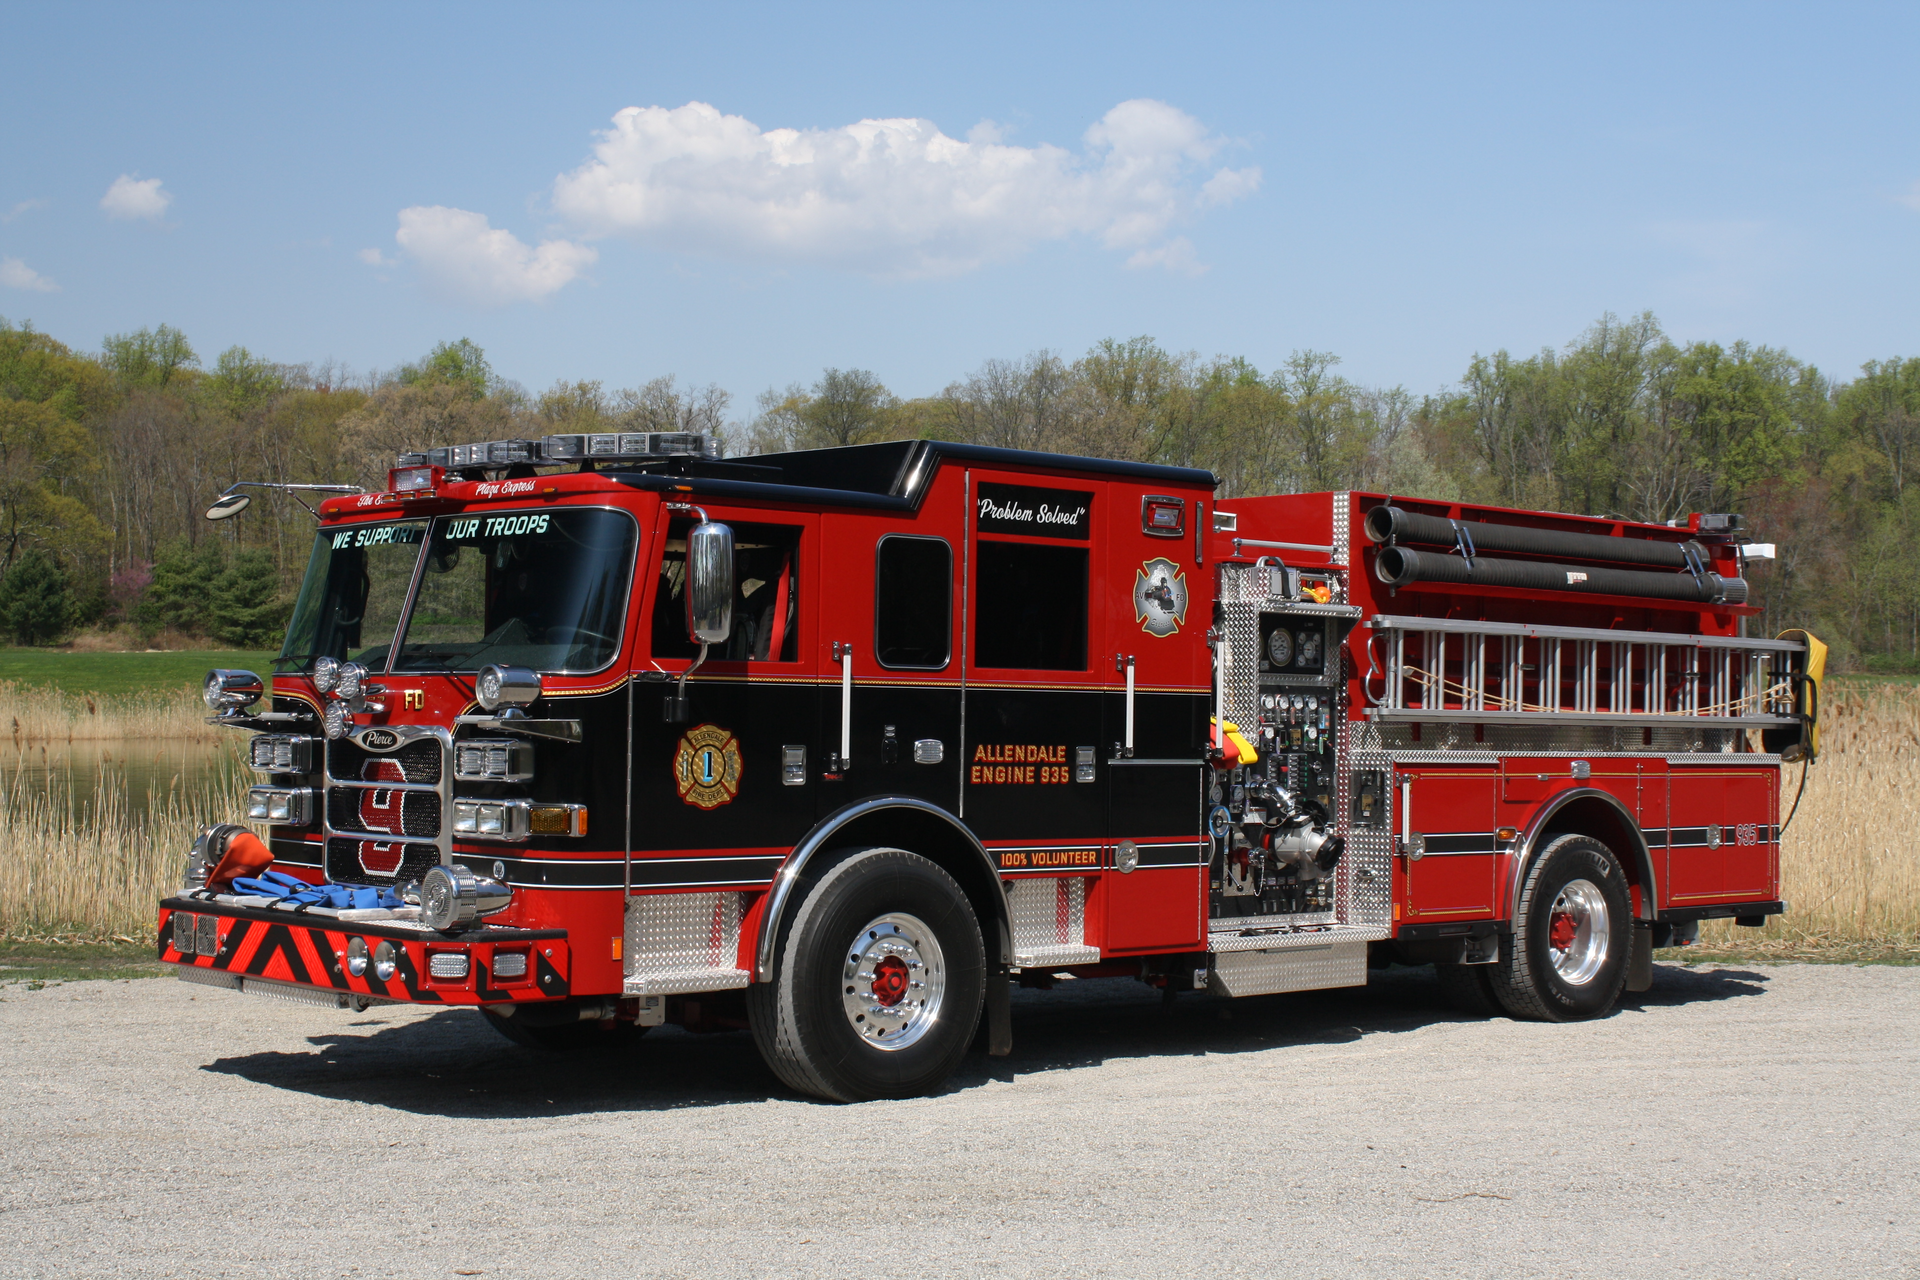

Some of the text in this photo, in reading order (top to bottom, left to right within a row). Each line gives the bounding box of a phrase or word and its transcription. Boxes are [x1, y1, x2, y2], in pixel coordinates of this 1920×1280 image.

[475, 481, 536, 498] Plaza Express
[332, 514, 550, 550] WE SUPPORT OUR TROOPS
[1176, 593, 1185, 602] FD
[366, 731, 393, 747] Pierce
[693, 732, 724, 744] ALLENDALE
[973, 744, 1067, 763] ALLENDALE
[702, 750, 714, 782] 1
[970, 765, 1070, 785] ENGINE 935
[692, 788, 705, 799] FIRE
[1736, 823, 1757, 846] 935
[1000, 851, 1097, 867] 100% VOLUNTEER
